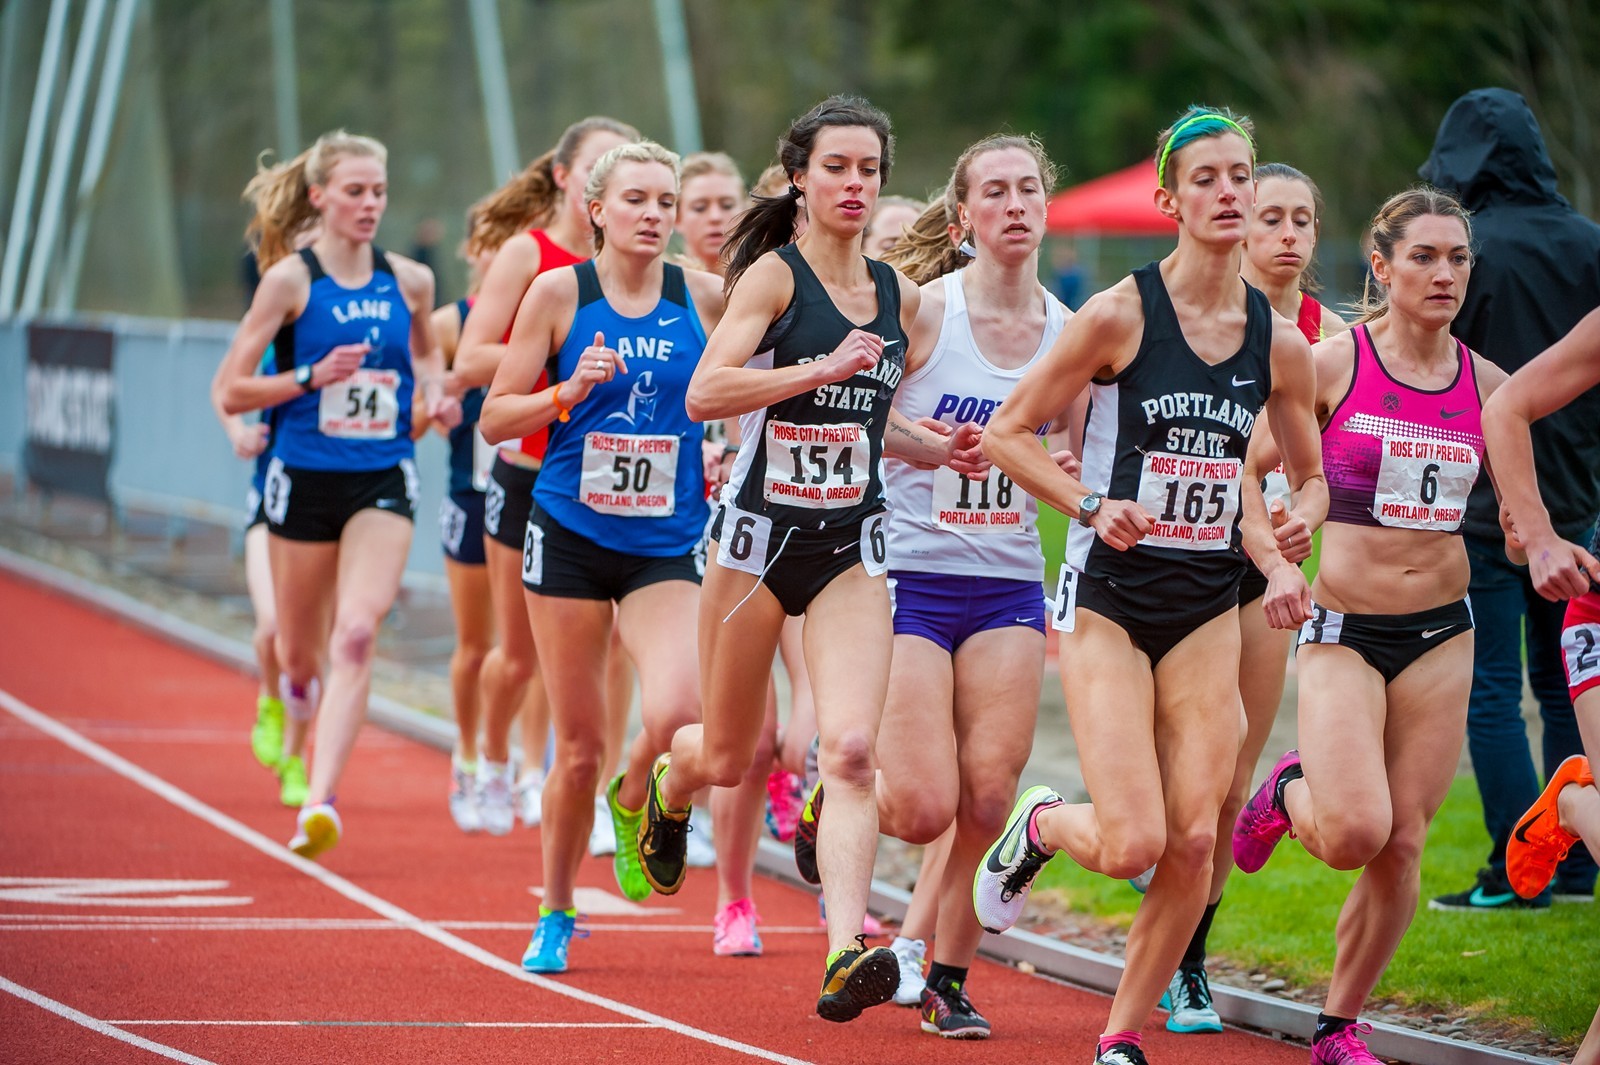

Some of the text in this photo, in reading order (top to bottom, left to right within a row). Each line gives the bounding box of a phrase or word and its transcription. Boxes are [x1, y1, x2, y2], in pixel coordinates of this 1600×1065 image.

[332, 299, 391, 324] LANE
[617, 336, 674, 362] ANE
[346, 387, 378, 418] 54
[814, 384, 877, 412] STATE
[1141, 392, 1255, 438] PORTLAND
[592, 435, 672, 453] ROSE CITY PREVIEW
[774, 424, 860, 442] ROSE CITY PREVIEW
[1166, 427, 1230, 458] STATE
[790, 445, 853, 485] 154
[1390, 441, 1472, 464] ROSE CITY PREVIEW
[612, 455, 652, 493] 50
[1150, 457, 1237, 479] ROSE CITY PREVIEW
[772, 483, 861, 503] PORTLAND, OREGON
[956, 472, 1013, 509] 118
[1420, 463, 1440, 505] 6
[587, 492, 667, 508] PORTLAND, OREGON
[1160, 480, 1228, 525] 165
[1381, 503, 1462, 523] PORTLAND, OREGON
[940, 511, 1020, 526] PORTLAND, OREGON
[1149, 523, 1225, 542] ORTLAND, OREGON
[729, 516, 756, 561] 6
[870, 517, 886, 564] 6
[1057, 571, 1073, 622] 5
[1574, 628, 1598, 673] 2
